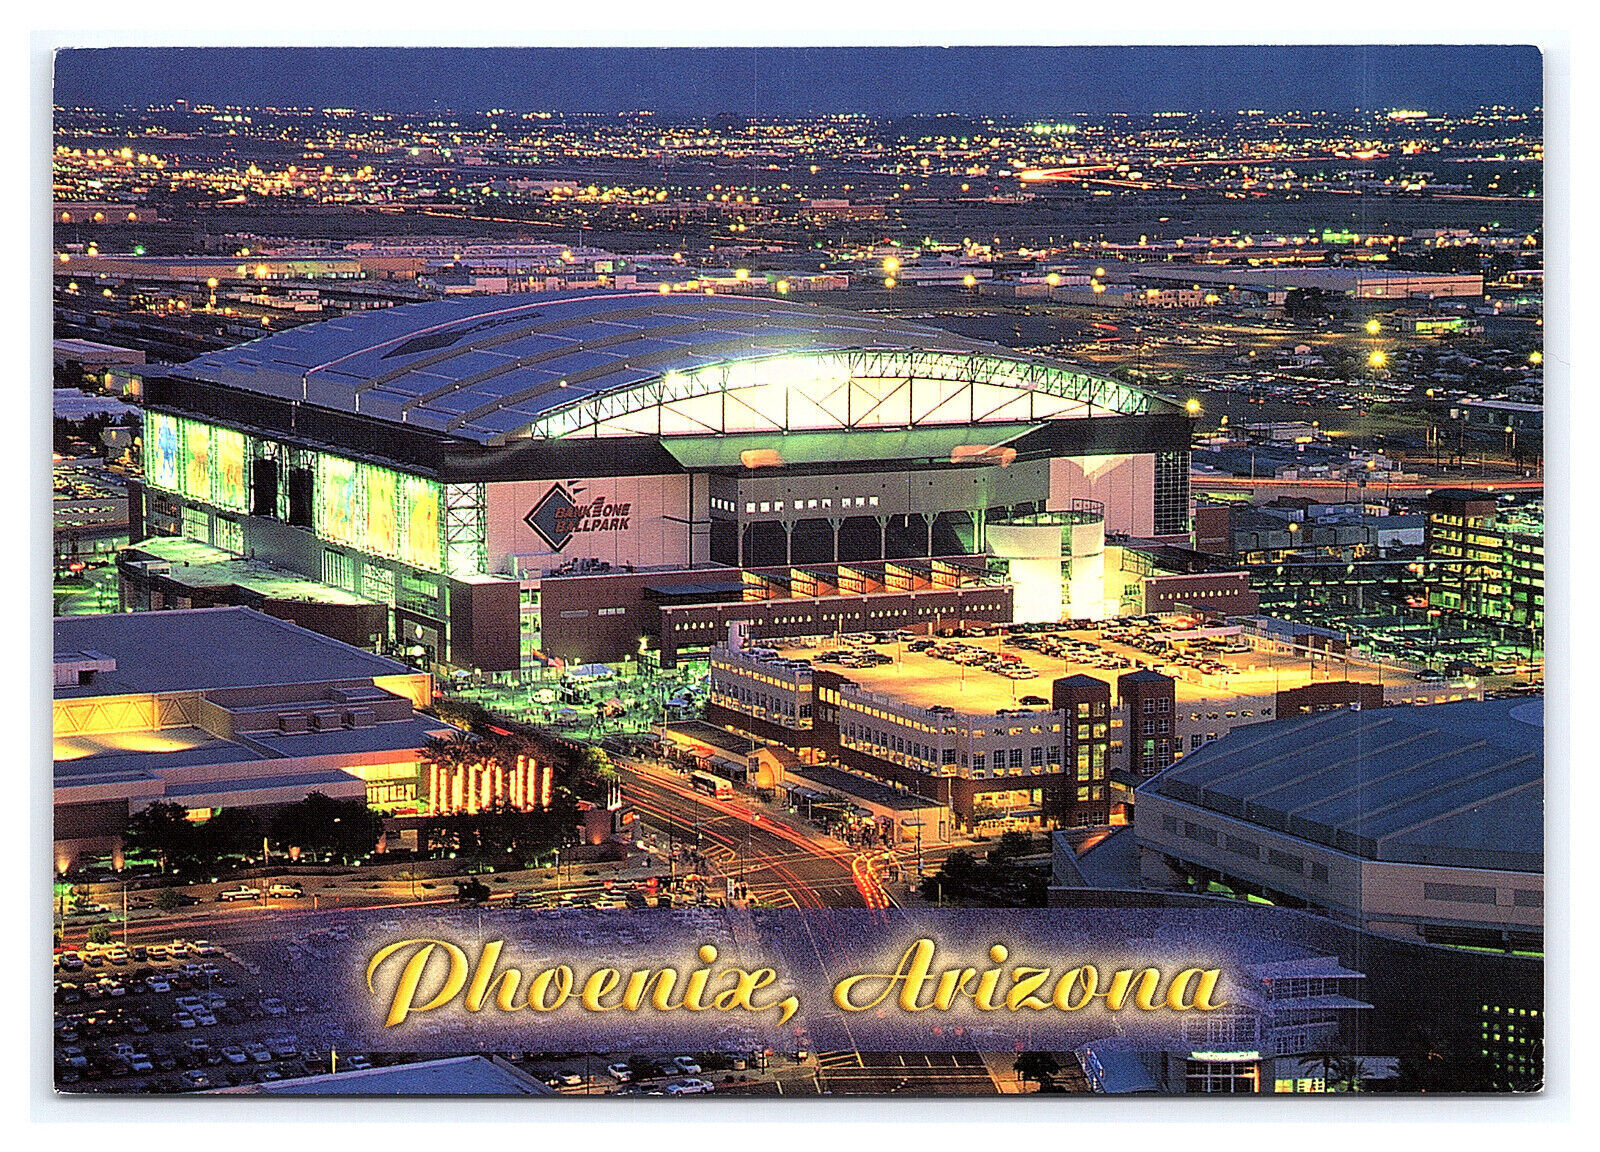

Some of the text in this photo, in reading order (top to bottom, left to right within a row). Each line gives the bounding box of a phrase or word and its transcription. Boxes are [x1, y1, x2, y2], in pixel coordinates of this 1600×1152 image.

[554, 503, 631, 519] BANK ONE
[555, 517, 630, 533] BALLPARK
